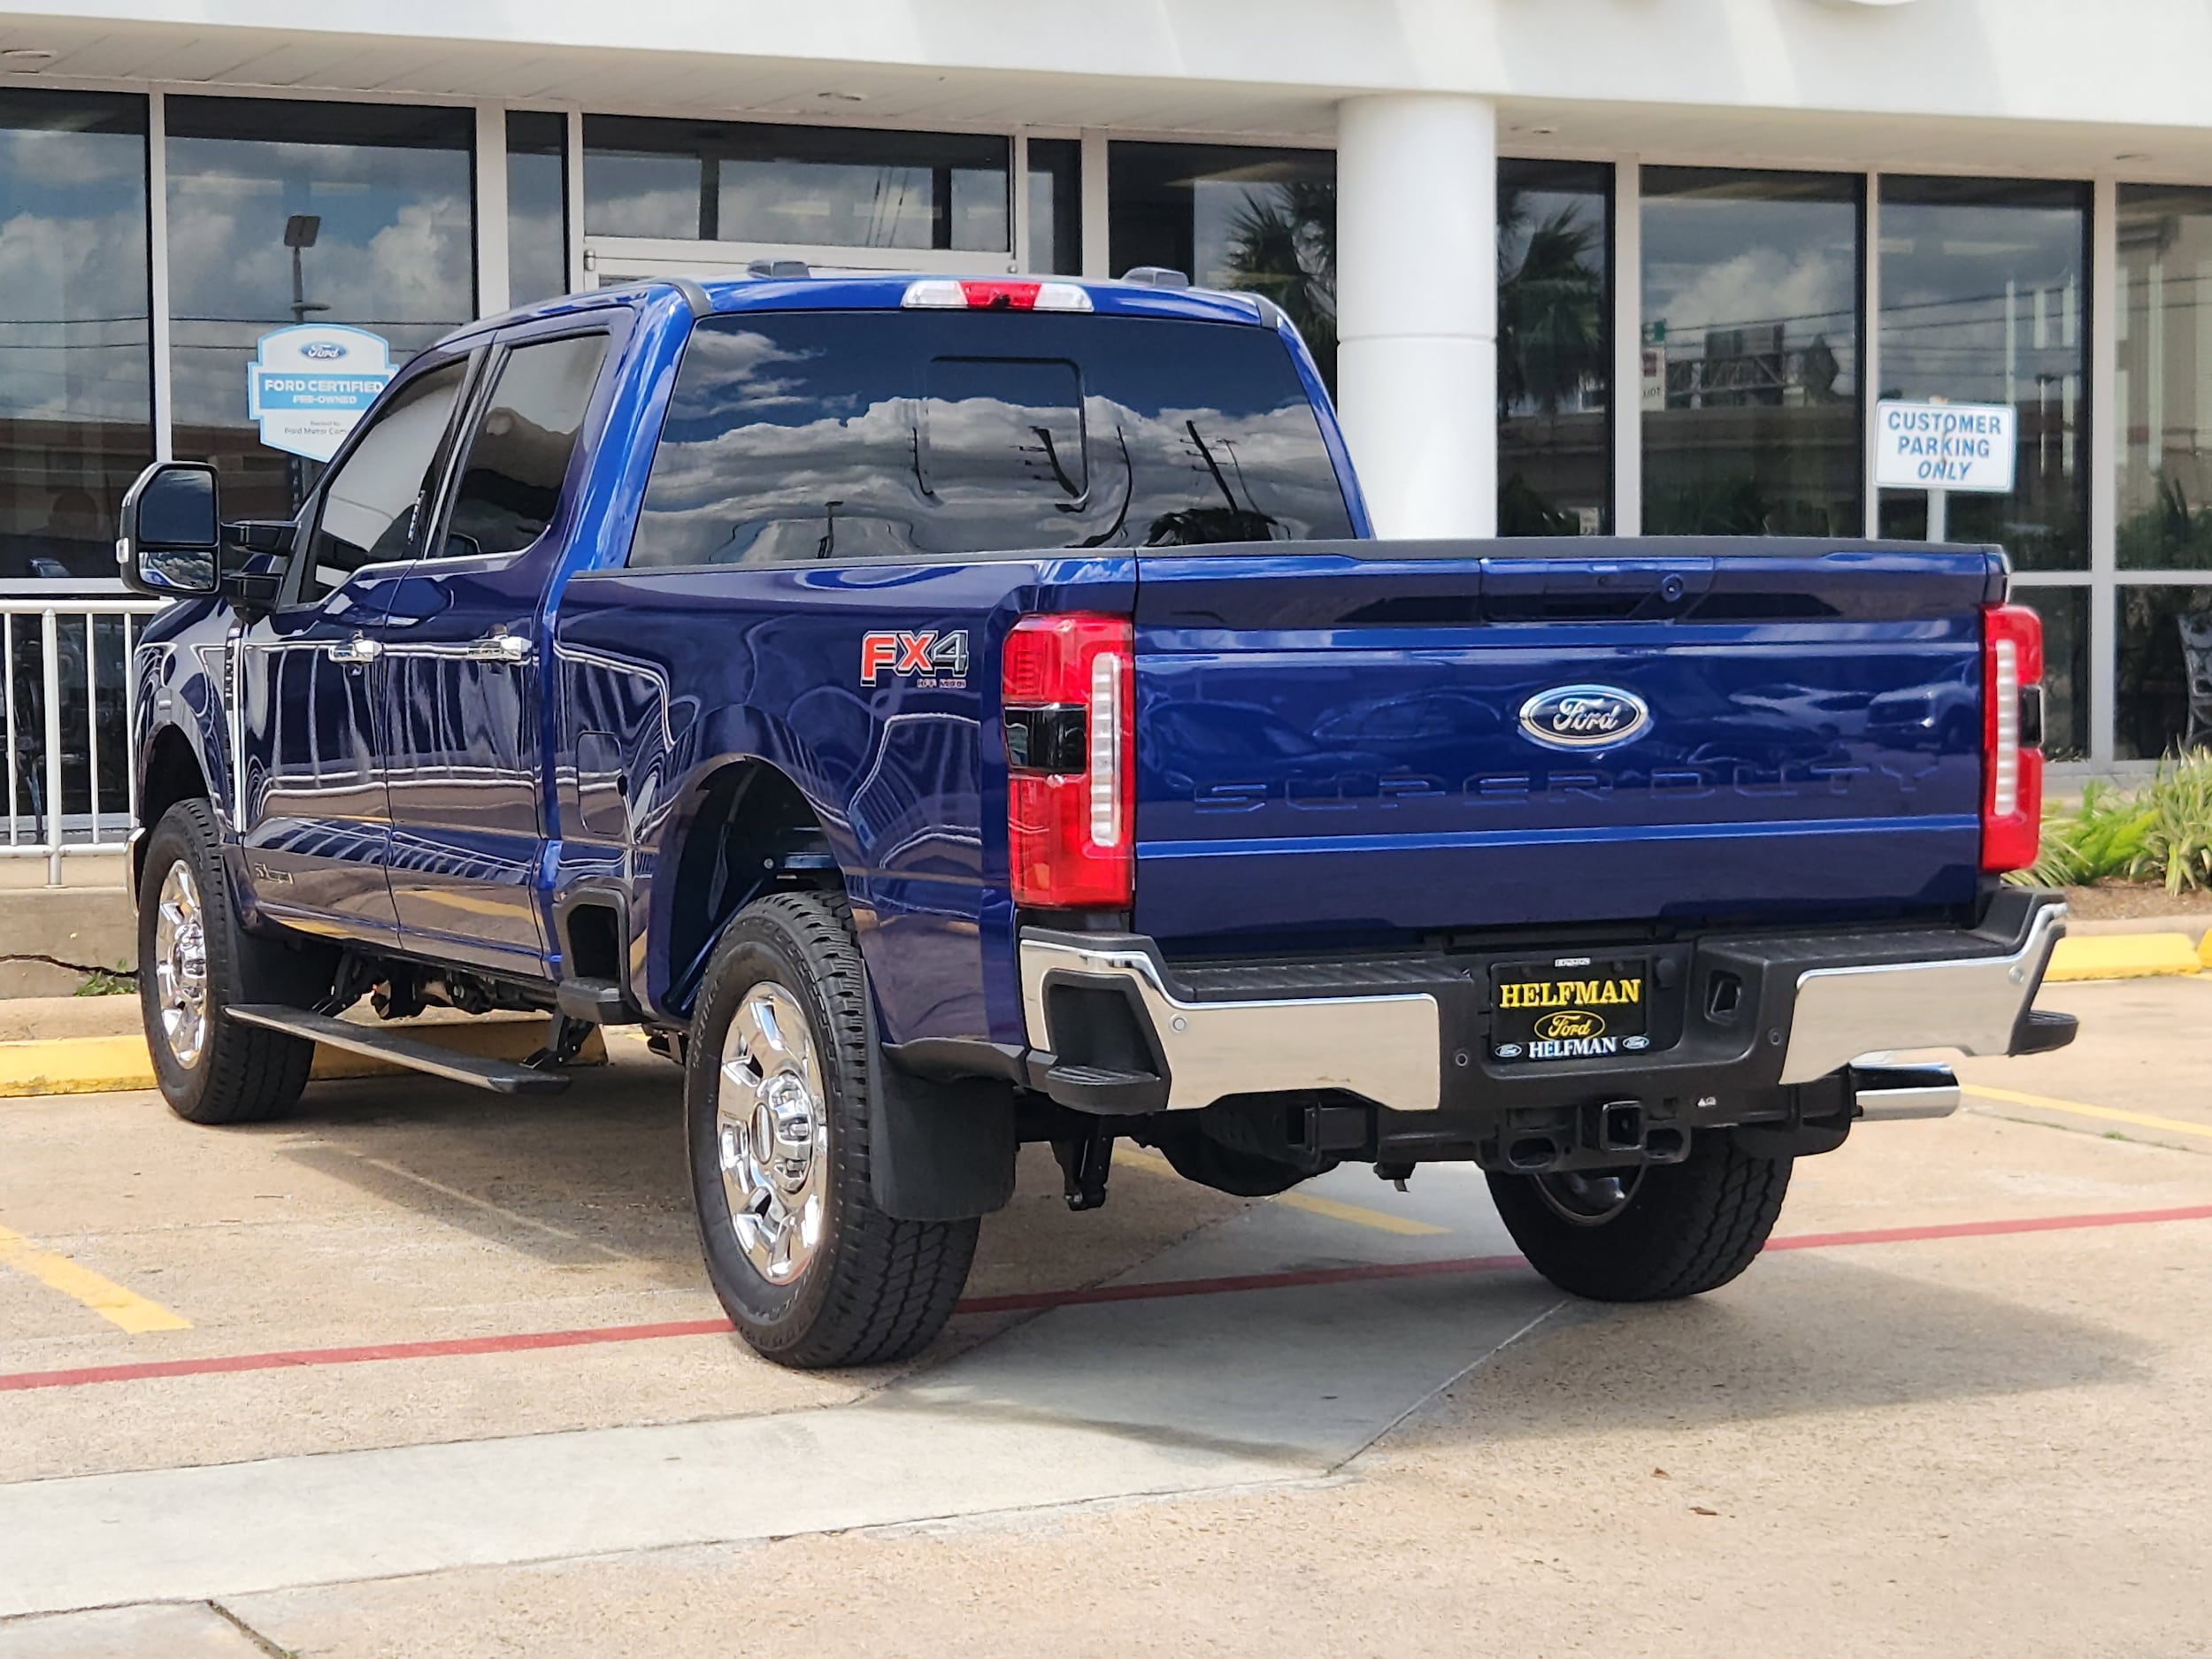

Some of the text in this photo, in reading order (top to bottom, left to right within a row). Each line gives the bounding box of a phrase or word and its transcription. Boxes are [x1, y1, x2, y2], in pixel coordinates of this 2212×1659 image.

[307, 343, 339, 358] Ford
[265, 379, 384, 394] FORD CERTIFIED
[292, 395, 357, 404] PRE-OWNED
[1887, 411, 2002, 435] CUSTOMER
[1897, 435, 1990, 458] PARKING
[1917, 460, 1972, 481] ONLY
[860, 630, 970, 687] FX4
[1552, 697, 1623, 732] Ford
[1193, 762, 1940, 814] SUPER DUTY
[1499, 978, 1642, 1009] HELFMAN
[1548, 1014, 1593, 1038] Ford
[1528, 1036, 1618, 1059] HELFMAN
